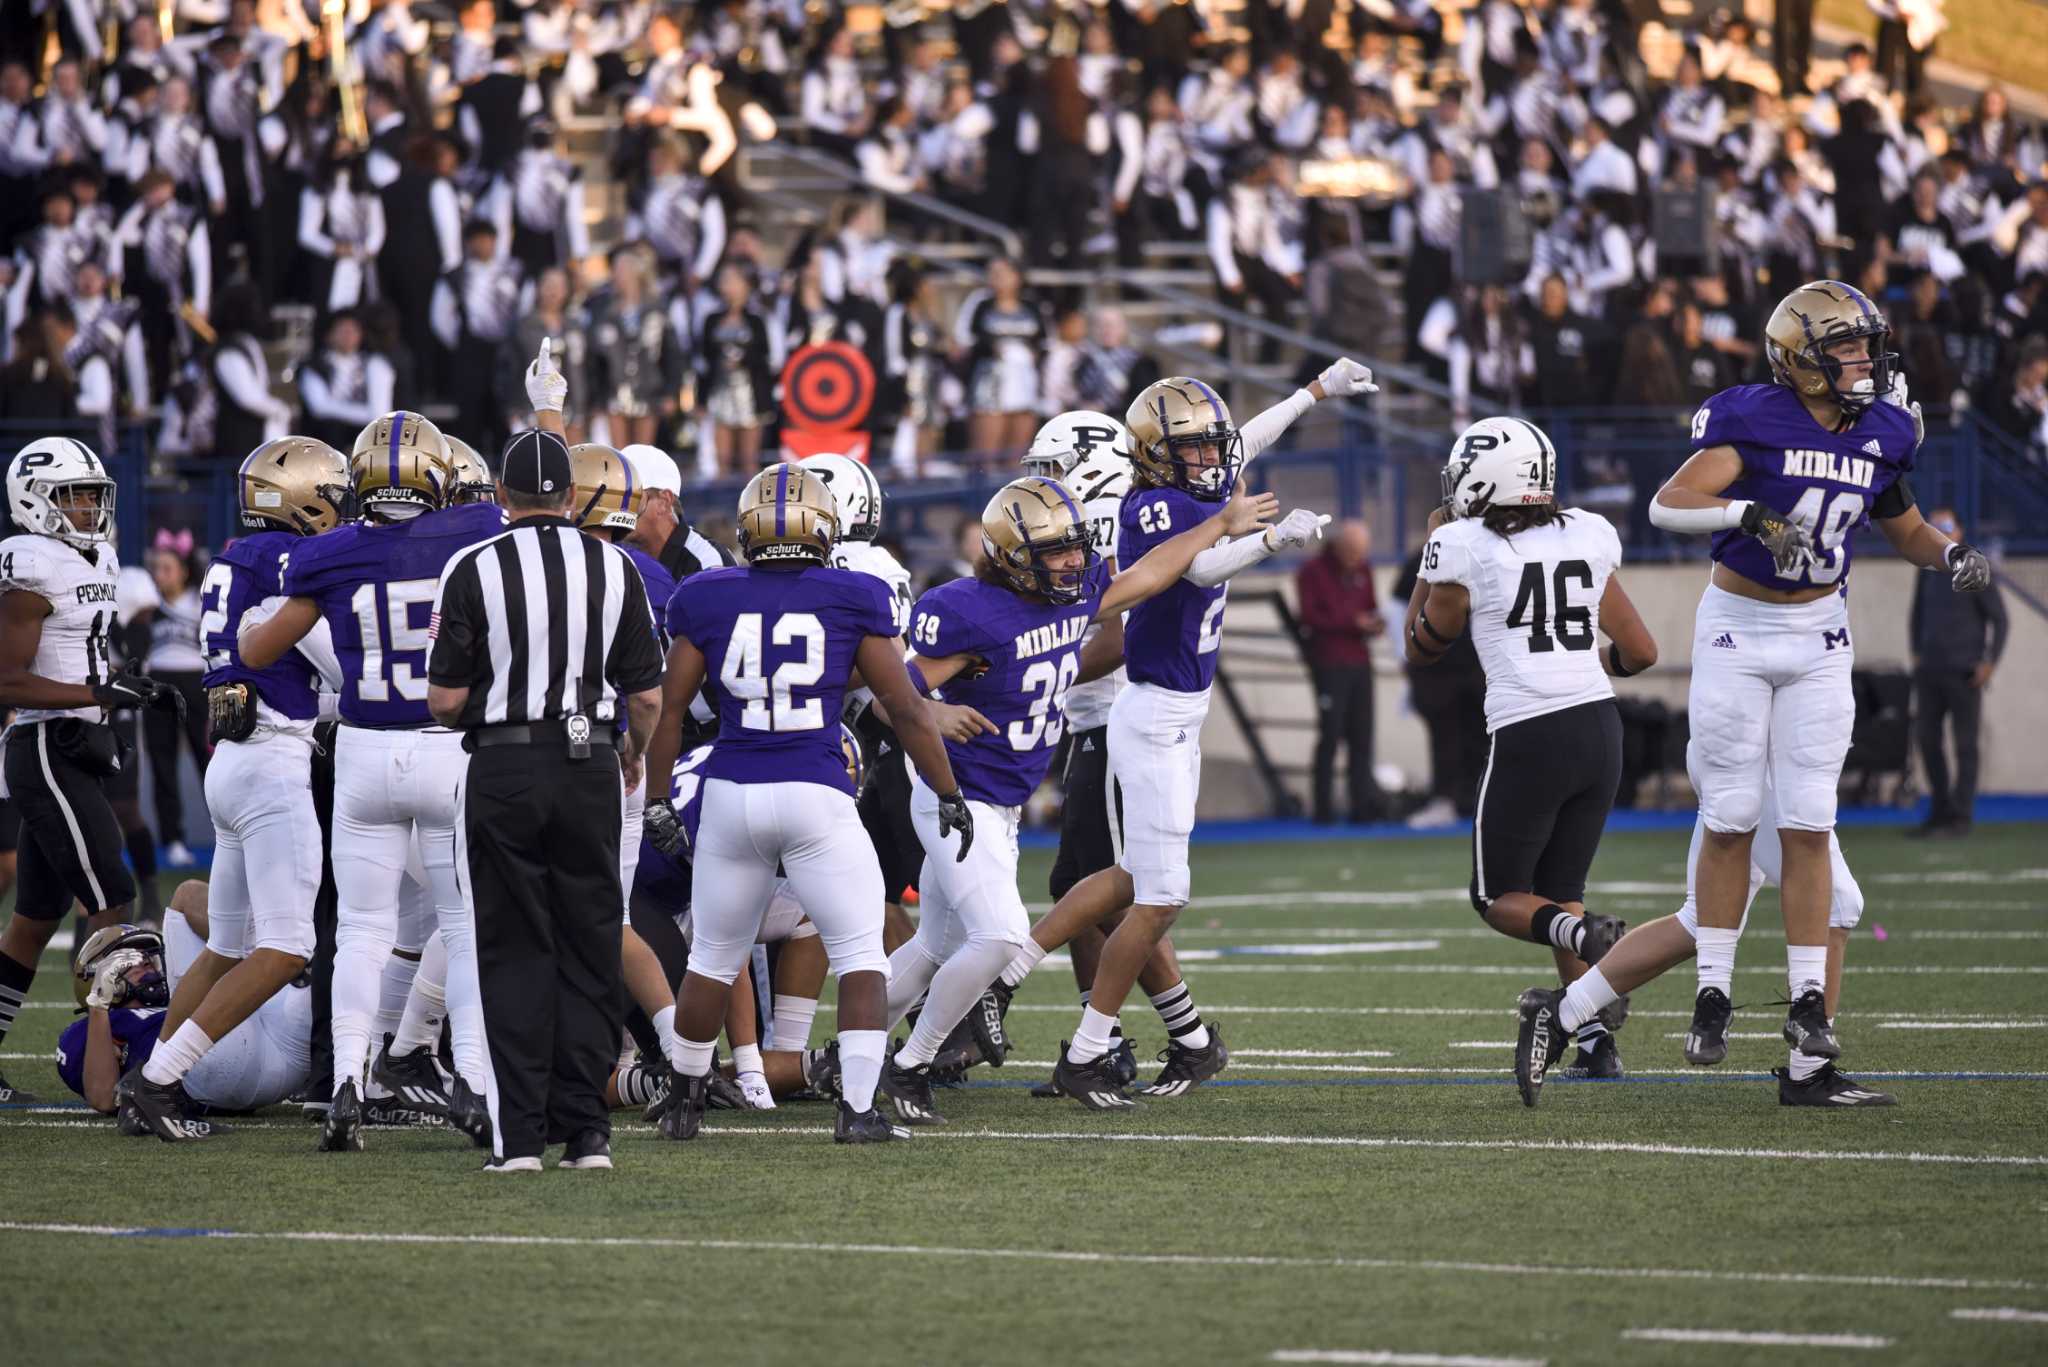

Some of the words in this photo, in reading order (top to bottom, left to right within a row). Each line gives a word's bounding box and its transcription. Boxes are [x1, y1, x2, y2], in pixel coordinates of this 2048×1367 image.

[1072, 426, 1117, 449] P
[1460, 435, 1498, 458] P
[16, 452, 54, 478] P
[1783, 450, 1875, 489] MIDLAND
[376, 487, 413, 497] schutt
[1139, 501, 1172, 534] 23
[766, 544, 802, 554] schutt
[1506, 560, 1594, 653] 46
[351, 578, 440, 702] 15
[915, 613, 940, 646] 39
[1822, 628, 1850, 651] M
[720, 613, 825, 732] 42
